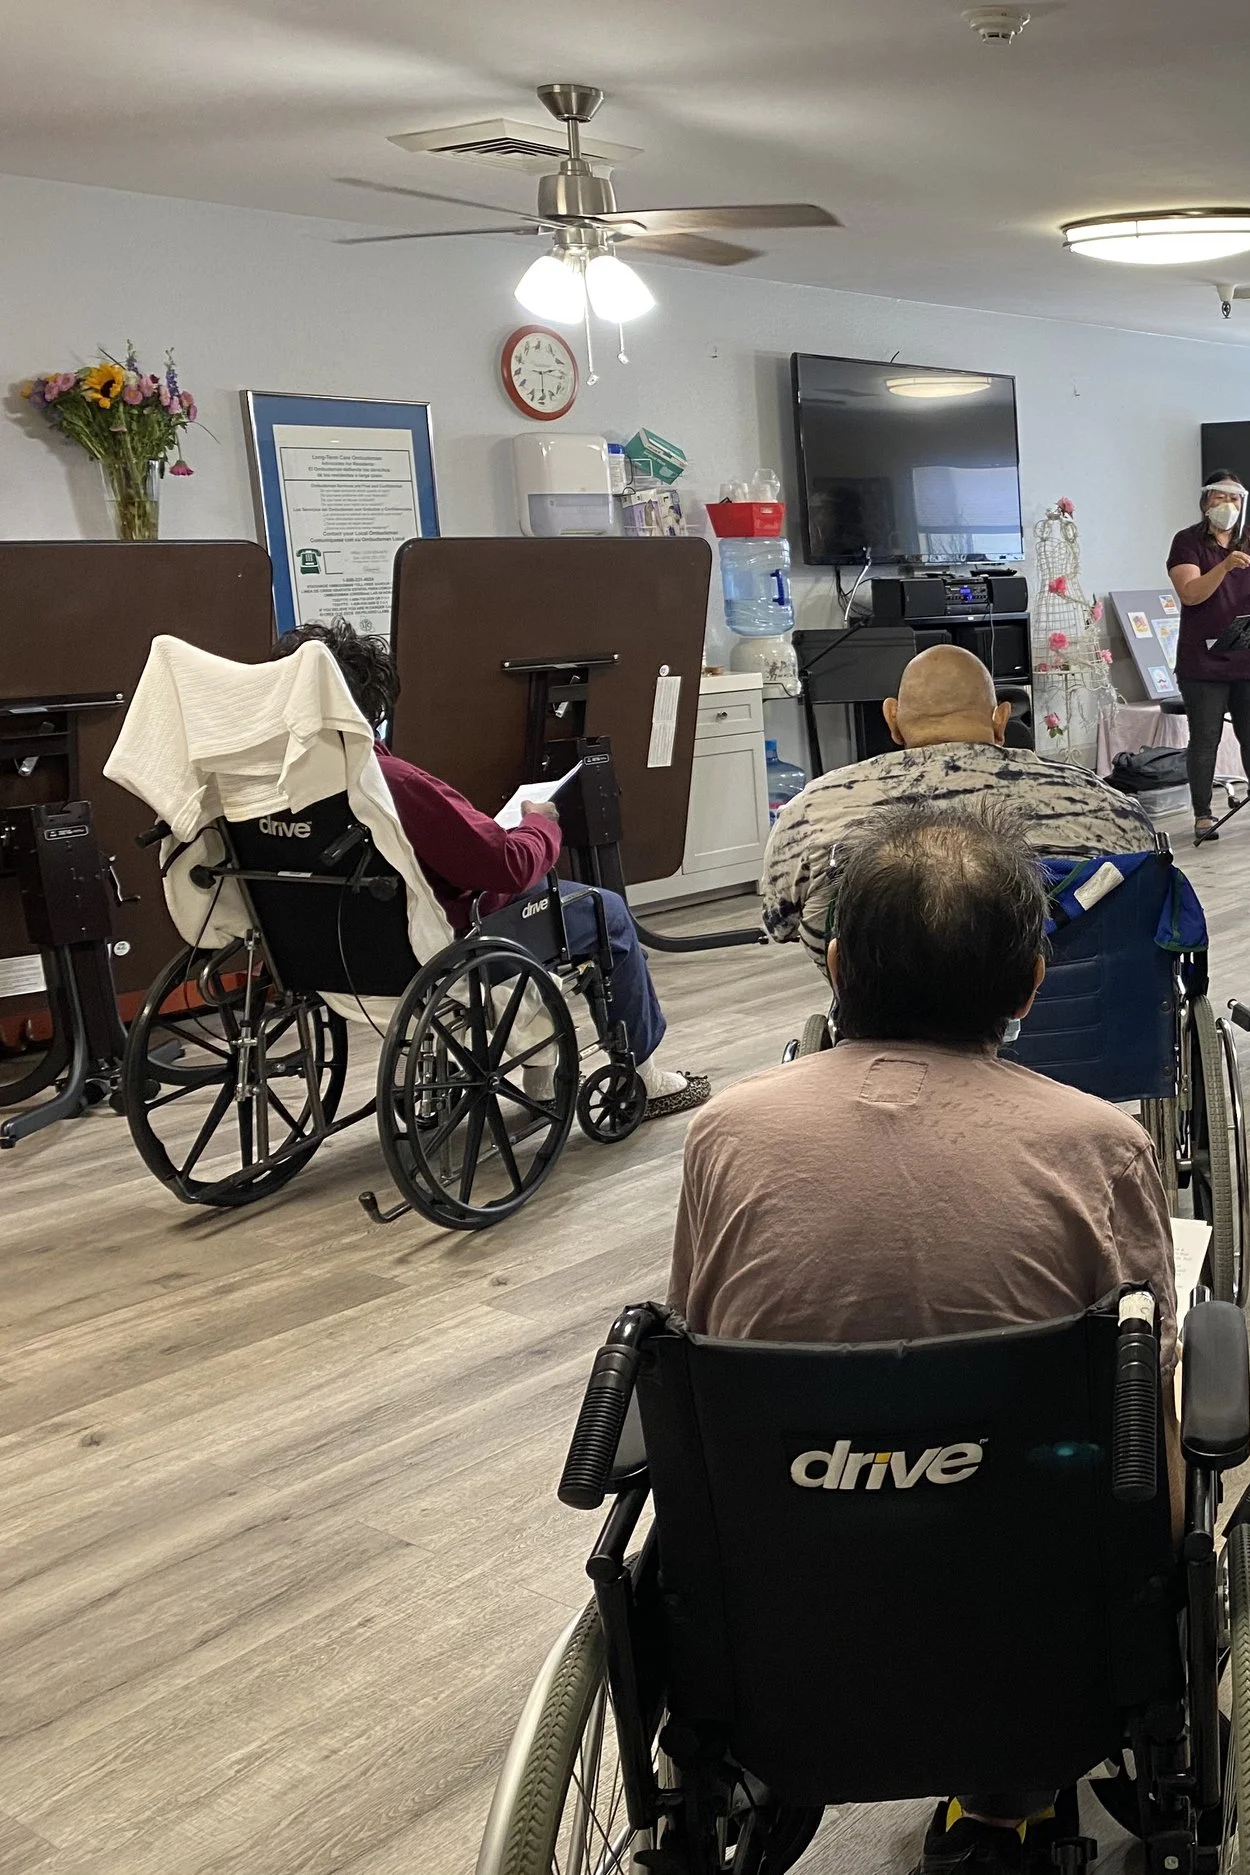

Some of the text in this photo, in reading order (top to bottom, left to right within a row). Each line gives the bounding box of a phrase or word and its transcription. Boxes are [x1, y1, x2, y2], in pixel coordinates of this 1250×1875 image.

[259, 815, 312, 838] drive
[522, 898, 549, 919] drive
[790, 1439, 984, 1490] drive
